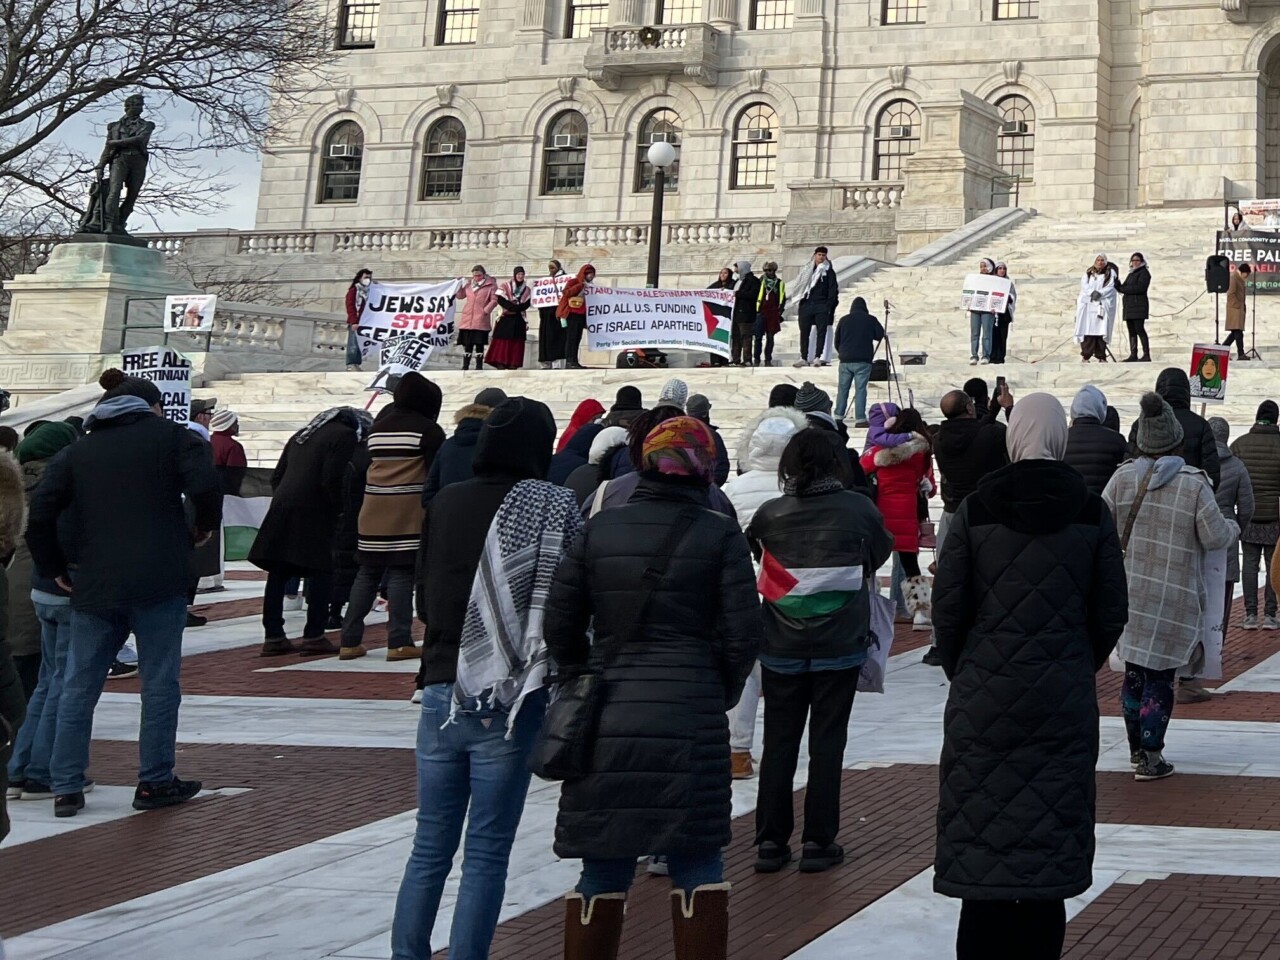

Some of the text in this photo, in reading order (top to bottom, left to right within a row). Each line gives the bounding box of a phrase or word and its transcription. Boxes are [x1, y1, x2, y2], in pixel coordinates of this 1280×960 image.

[584, 285, 613, 296] STAND
[368, 293, 457, 313] JEWS SAY
[588, 303, 696, 317] END ALL U.S. FUNDING
[391, 313, 445, 330] STOP
[587, 320, 702, 334] OF ISRAELI APARTHEID
[122, 351, 190, 372] FREE ALL
[123, 369, 189, 382] ESTINIAN
